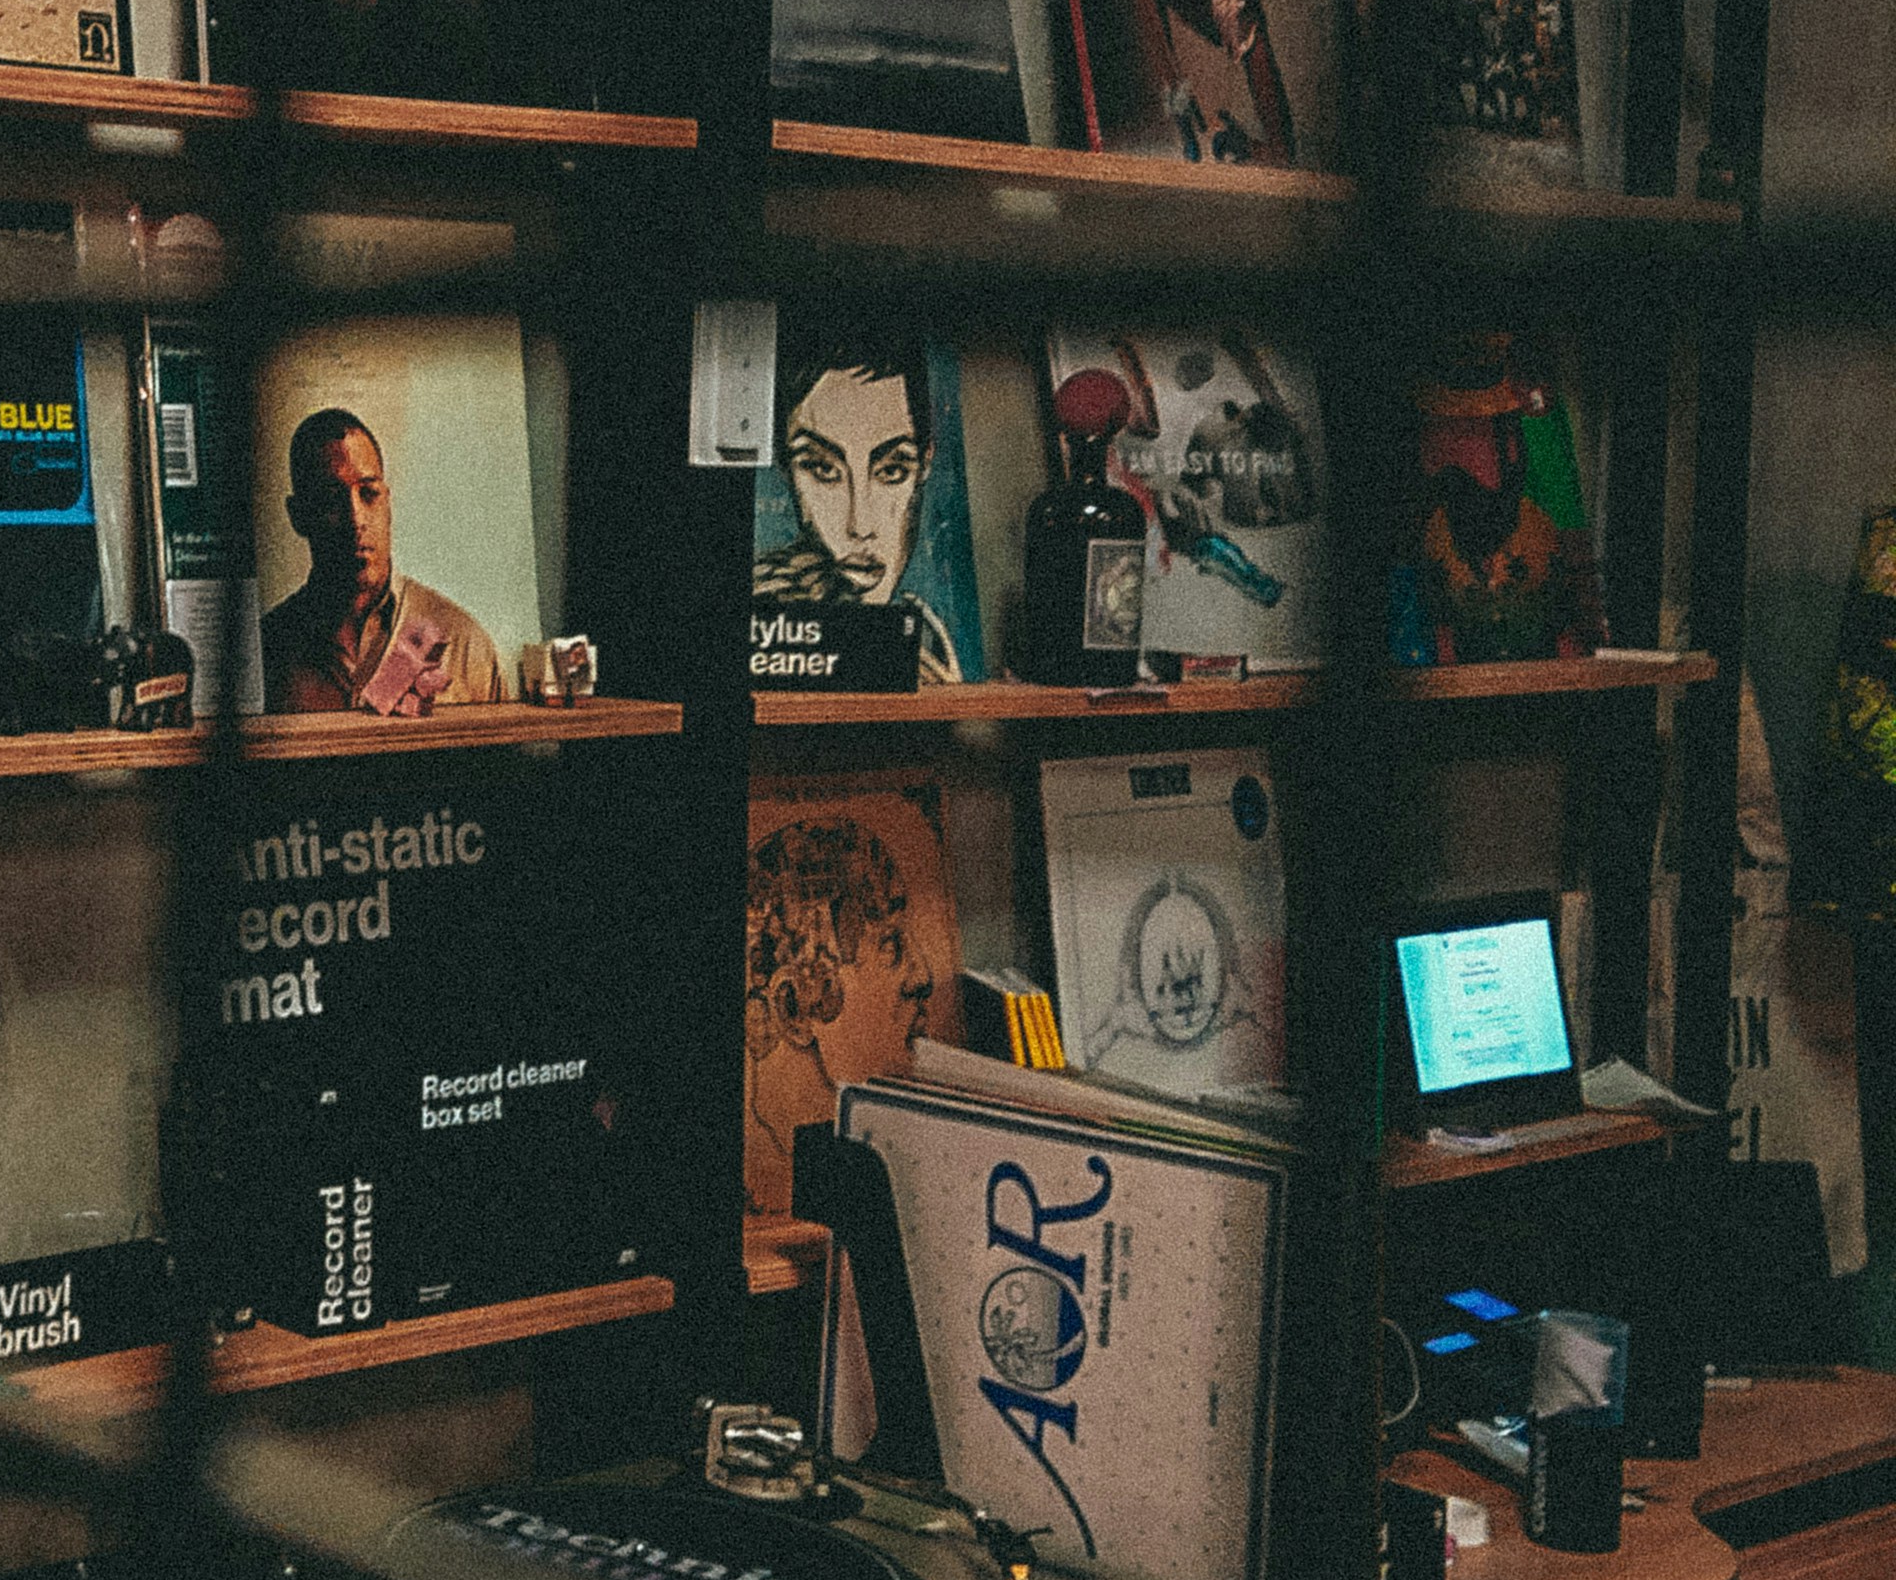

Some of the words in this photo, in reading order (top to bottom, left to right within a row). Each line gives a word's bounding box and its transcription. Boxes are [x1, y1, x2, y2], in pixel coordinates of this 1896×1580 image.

[750, 613, 822, 646] tylus
[750, 650, 838, 676] eaner
[239, 808, 486, 882] nti-static
[237, 878, 392, 952] ecord
[221, 957, 324, 1024] mat
[420, 1065, 503, 1101] Record
[506, 1057, 588, 1089] cleaner
[420, 1101, 463, 1130] box
[467, 1096, 503, 1124] set
[317, 1184, 345, 1327] Record
[345, 1176, 373, 1322] cleaner
